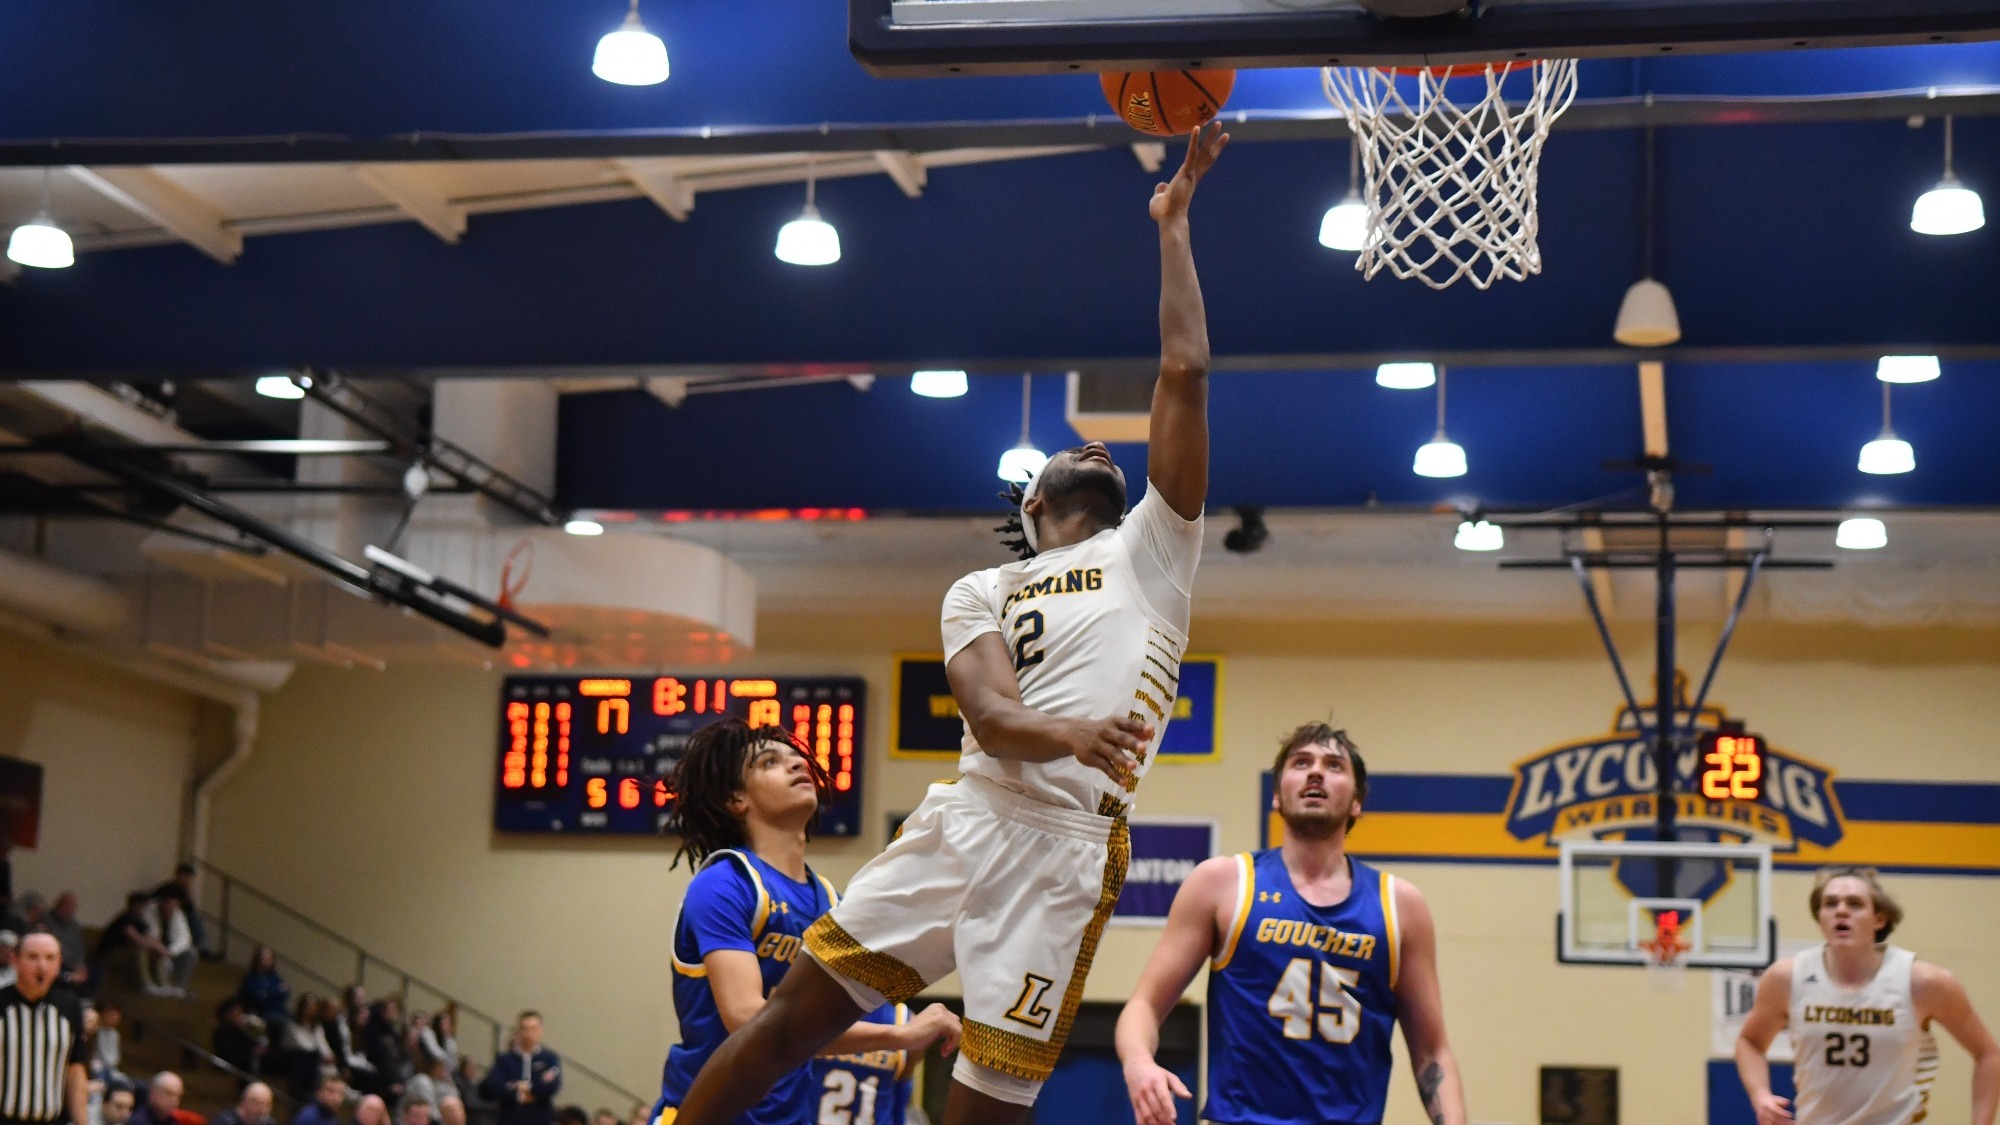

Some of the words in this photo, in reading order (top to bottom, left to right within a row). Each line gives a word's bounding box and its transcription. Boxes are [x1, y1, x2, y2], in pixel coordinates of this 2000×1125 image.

[1013, 608, 1044, 672] 2
[1702, 753, 1761, 799] 22
[1567, 799, 1779, 832] WARIORS
[1256, 917, 1377, 961] GOUCHER
[1003, 972, 1053, 1030] L
[1268, 957, 1363, 1044] 45
[1803, 1005, 1896, 1027] LYCOMING
[1825, 1031, 1870, 1068] 23
[816, 1068, 879, 1125] 21
